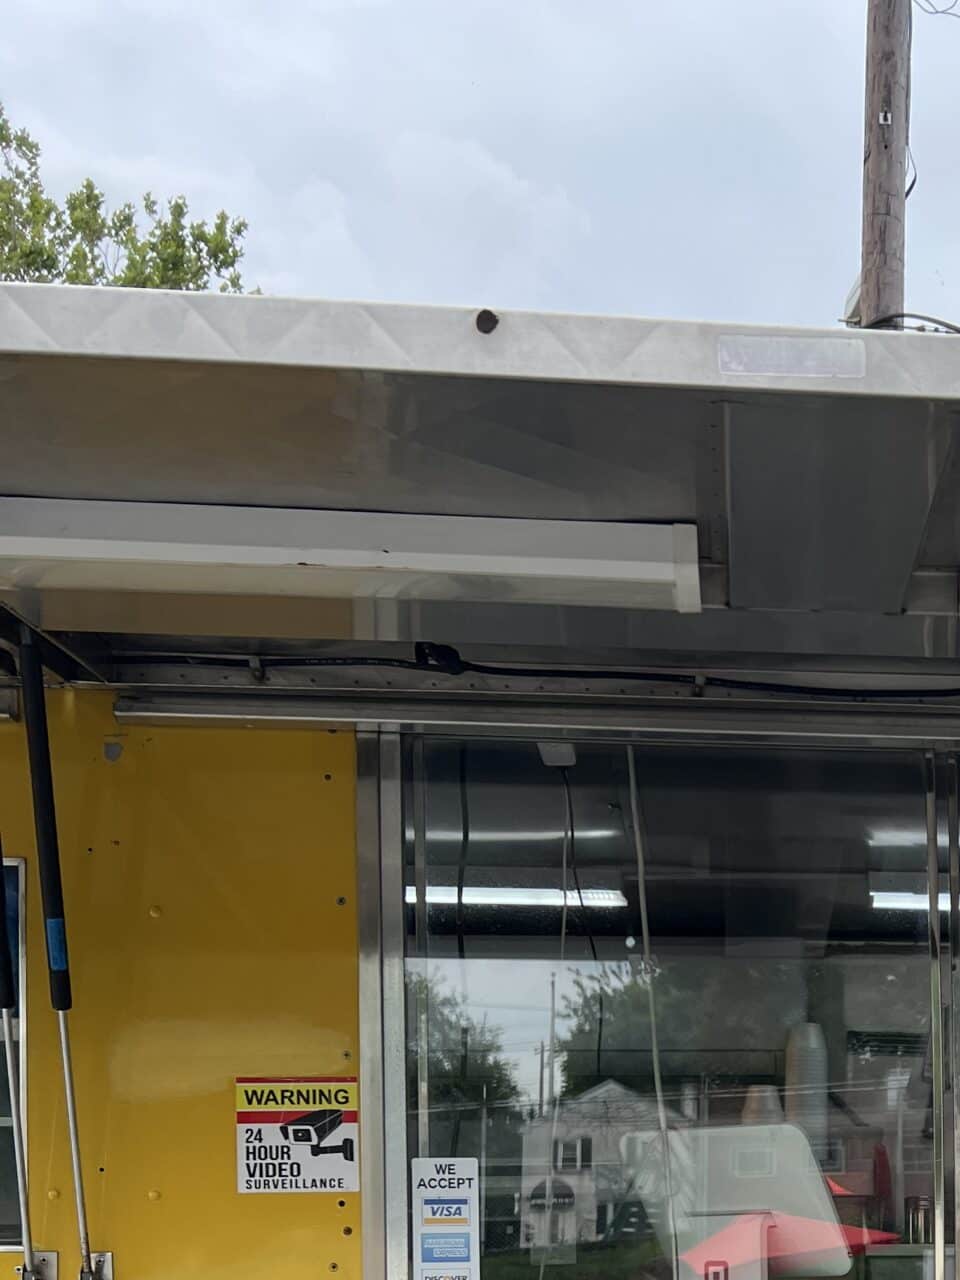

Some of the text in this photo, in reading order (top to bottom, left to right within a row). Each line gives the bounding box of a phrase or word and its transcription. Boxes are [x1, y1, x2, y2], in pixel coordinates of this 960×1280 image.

[244, 1088, 350, 1106] WARNING
[245, 1128, 263, 1144] 24
[245, 1145, 292, 1161] HOUR
[245, 1162, 301, 1178] VIDEO
[434, 1164, 456, 1175] WE
[245, 1178, 344, 1190] SURVEILLANCE
[416, 1178, 474, 1190] ACCEPT
[430, 1206, 462, 1216] VISA
